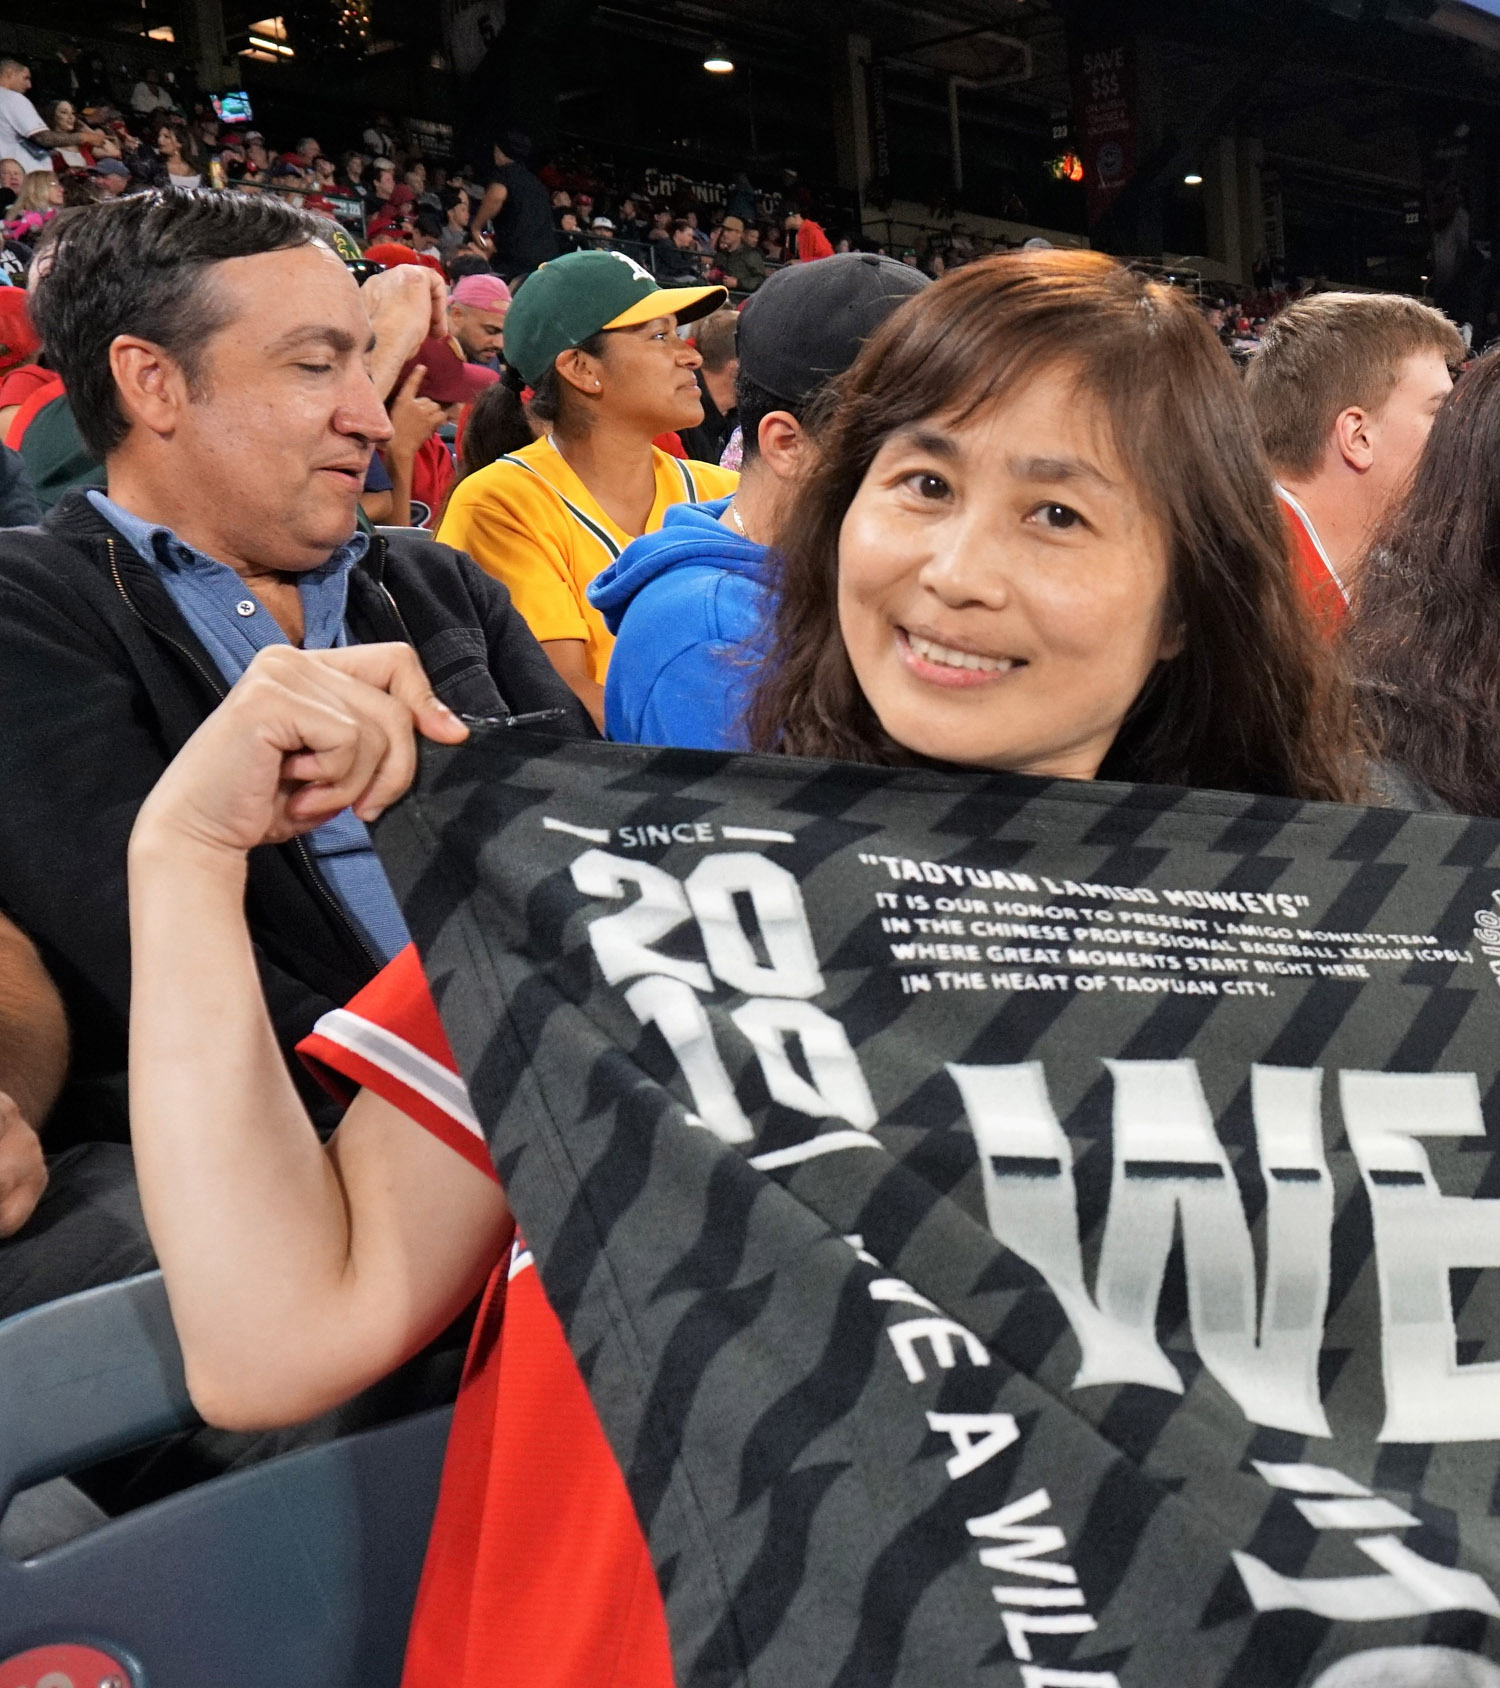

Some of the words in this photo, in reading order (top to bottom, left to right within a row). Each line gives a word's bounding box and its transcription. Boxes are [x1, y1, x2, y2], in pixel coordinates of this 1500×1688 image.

[618, 822, 717, 848] SINCE
[875, 892, 899, 909] IT
[905, 894, 931, 911] IS
[935, 897, 990, 914] OUR
[993, 901, 1078, 921] HONOR
[1079, 908, 1115, 923] TO
[1117, 910, 1208, 931] PRESENT
[1213, 921, 1293, 940] LAMIGO
[1296, 928, 1387, 945] MONKEYS
[1388, 934, 1438, 946] TEAM
[1040, 876, 1160, 904] LAMIGO
[1162, 889, 1310, 918] MONKEYS"
[569, 848, 827, 999] 20
[881, 917, 911, 935] IN
[914, 918, 966, 936] THE
[970, 921, 1071, 942] CHINESE
[1073, 927, 1237, 952] PROFESSIONAL
[1239, 940, 1338, 960] BASEBALL
[1340, 947, 1414, 961] LEAGUE
[1415, 948, 1474, 964] (CPBL)
[890, 943, 982, 962] WHERE
[986, 945, 1061, 964] GREAT
[1066, 948, 1182, 970] MOMENTS
[1185, 956, 1250, 973] START
[1253, 959, 1314, 977] RIGHT
[1317, 962, 1371, 978] HERE
[900, 973, 932, 994] IN
[935, 971, 988, 991] THE
[991, 972, 1069, 991] HEART
[1074, 974, 1108, 992] OF
[1110, 975, 1218, 996] TAOYUAN
[1221, 980, 1276, 998] CITY.
[925, 1410, 1021, 1481] A
